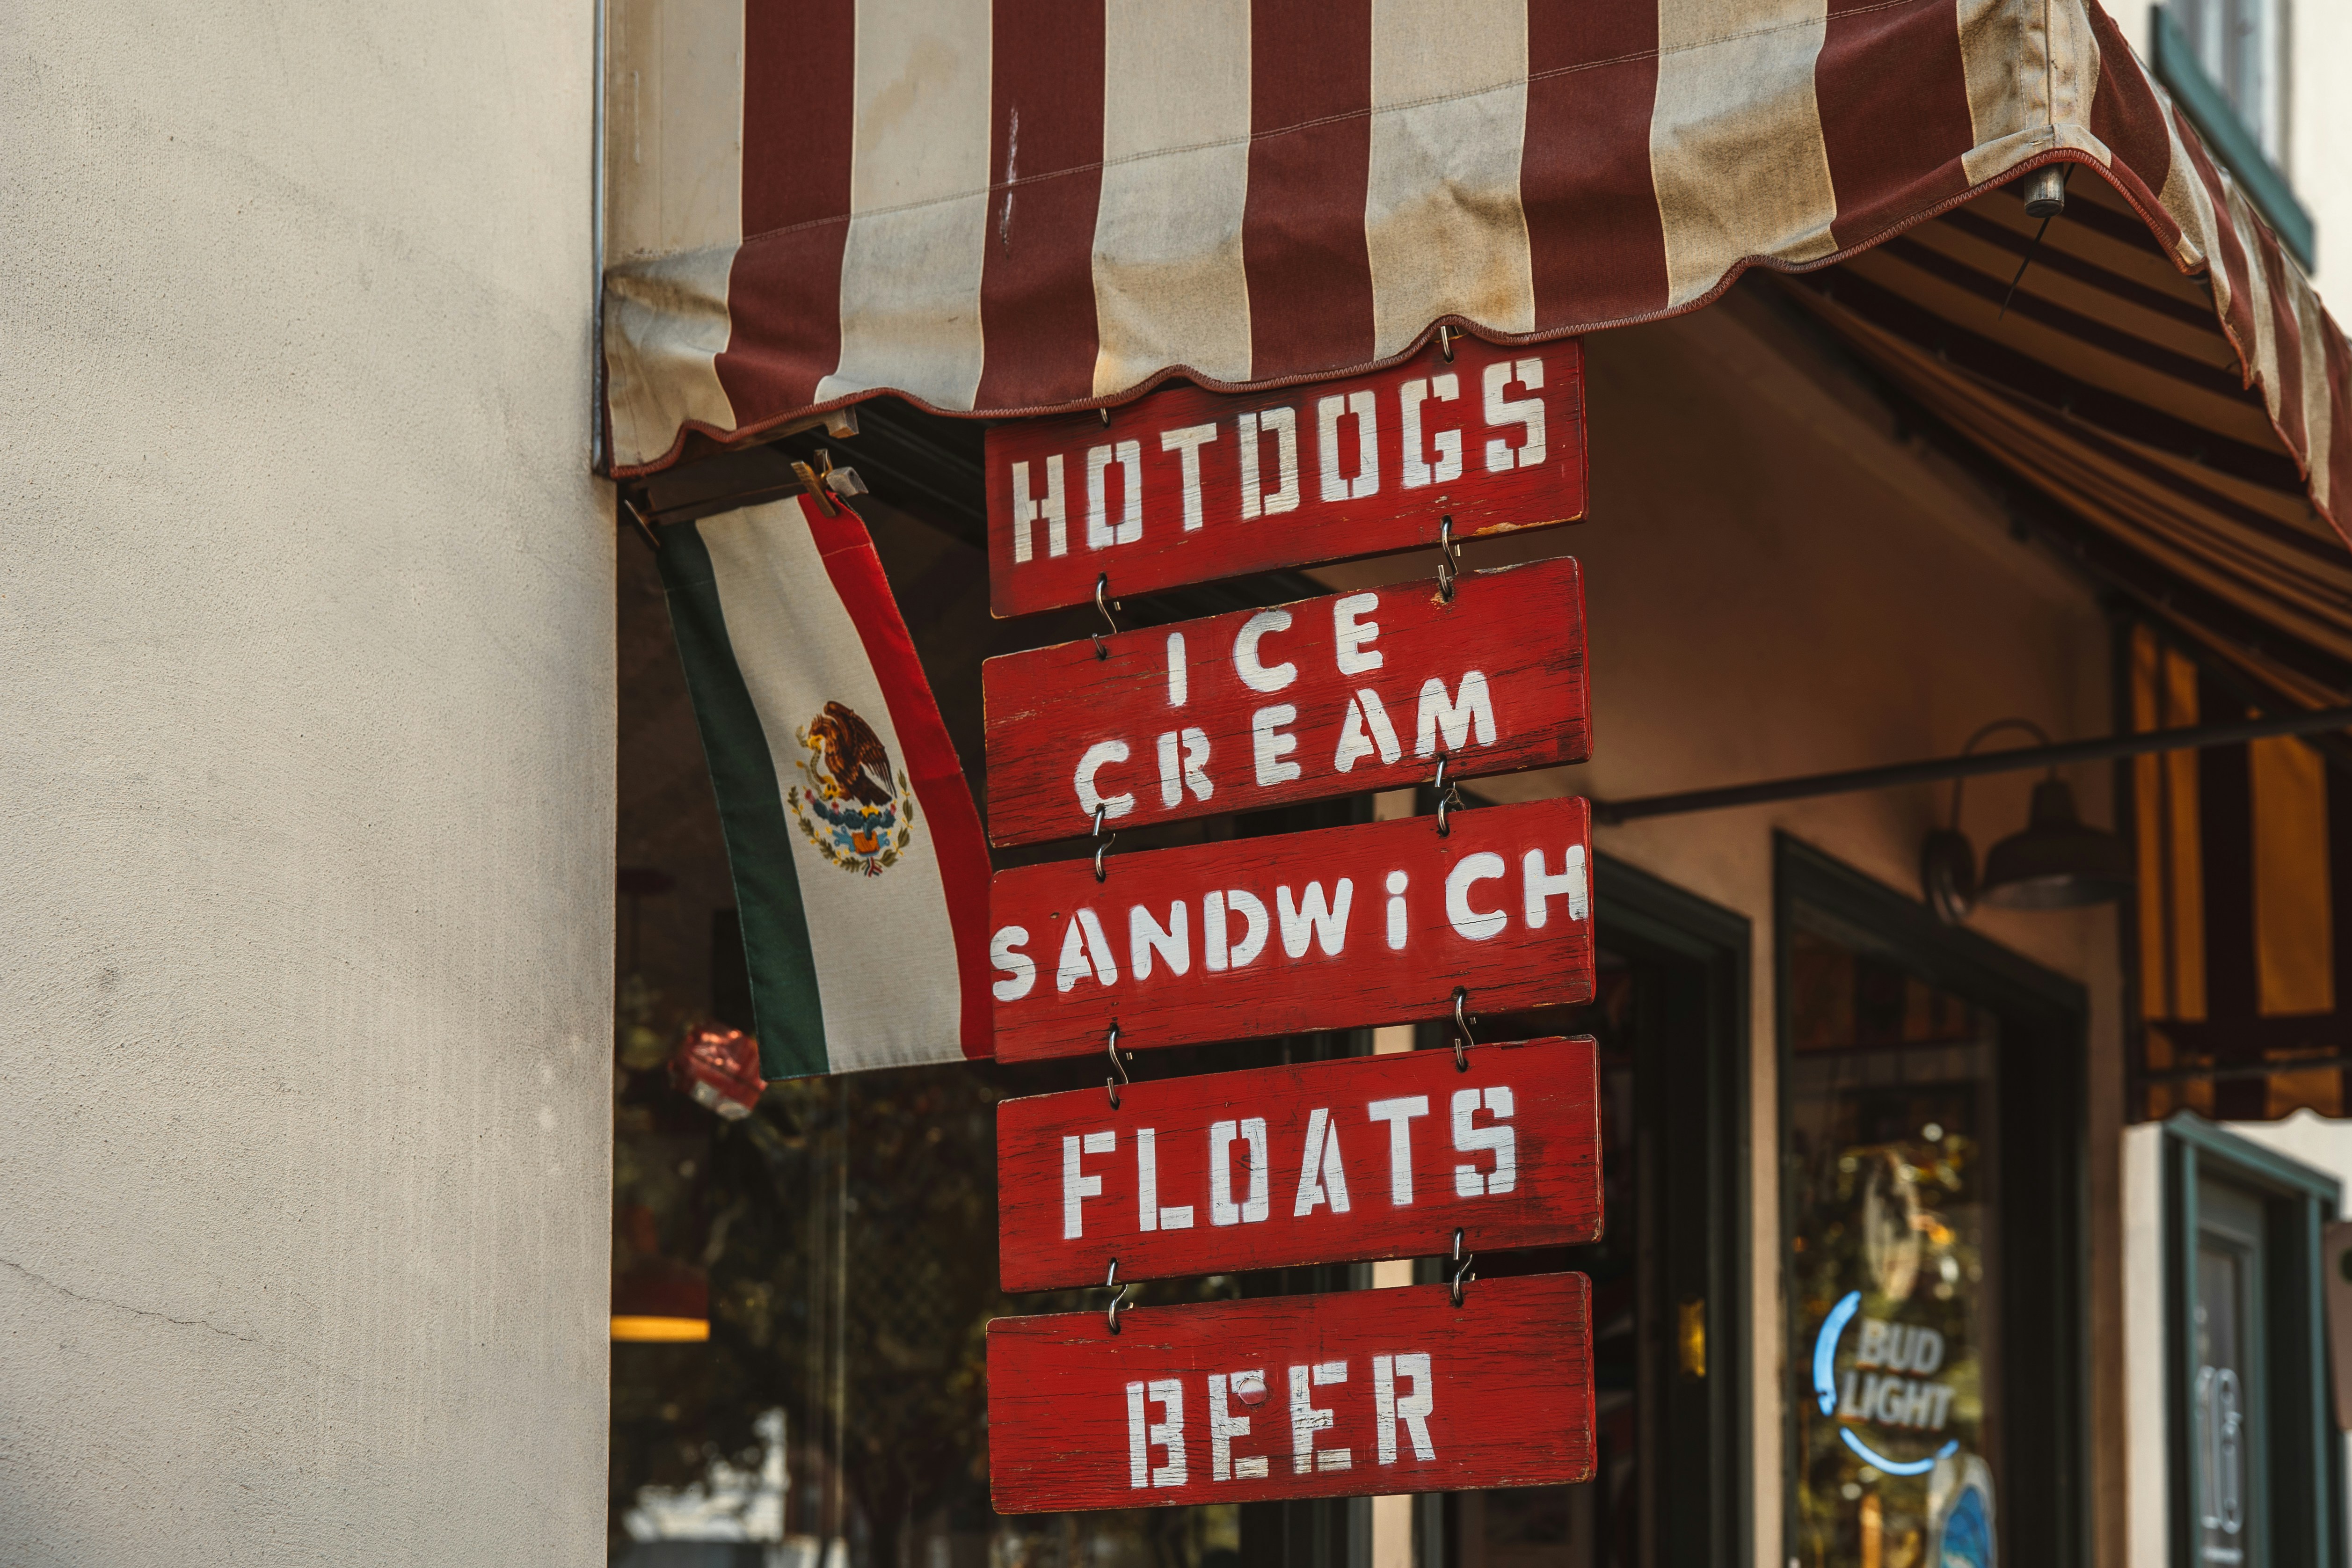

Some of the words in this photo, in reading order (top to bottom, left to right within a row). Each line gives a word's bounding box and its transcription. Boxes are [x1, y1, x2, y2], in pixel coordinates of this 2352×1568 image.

[1167, 592, 1384, 707] ICE
[1074, 670, 1497, 819] CREAM
[1062, 1086, 1516, 1240] FLOATS
[1838, 1371, 1953, 1430] LIGHT
[1857, 1319, 1944, 1375] BUD
[1126, 1352, 1435, 1488] BEER
